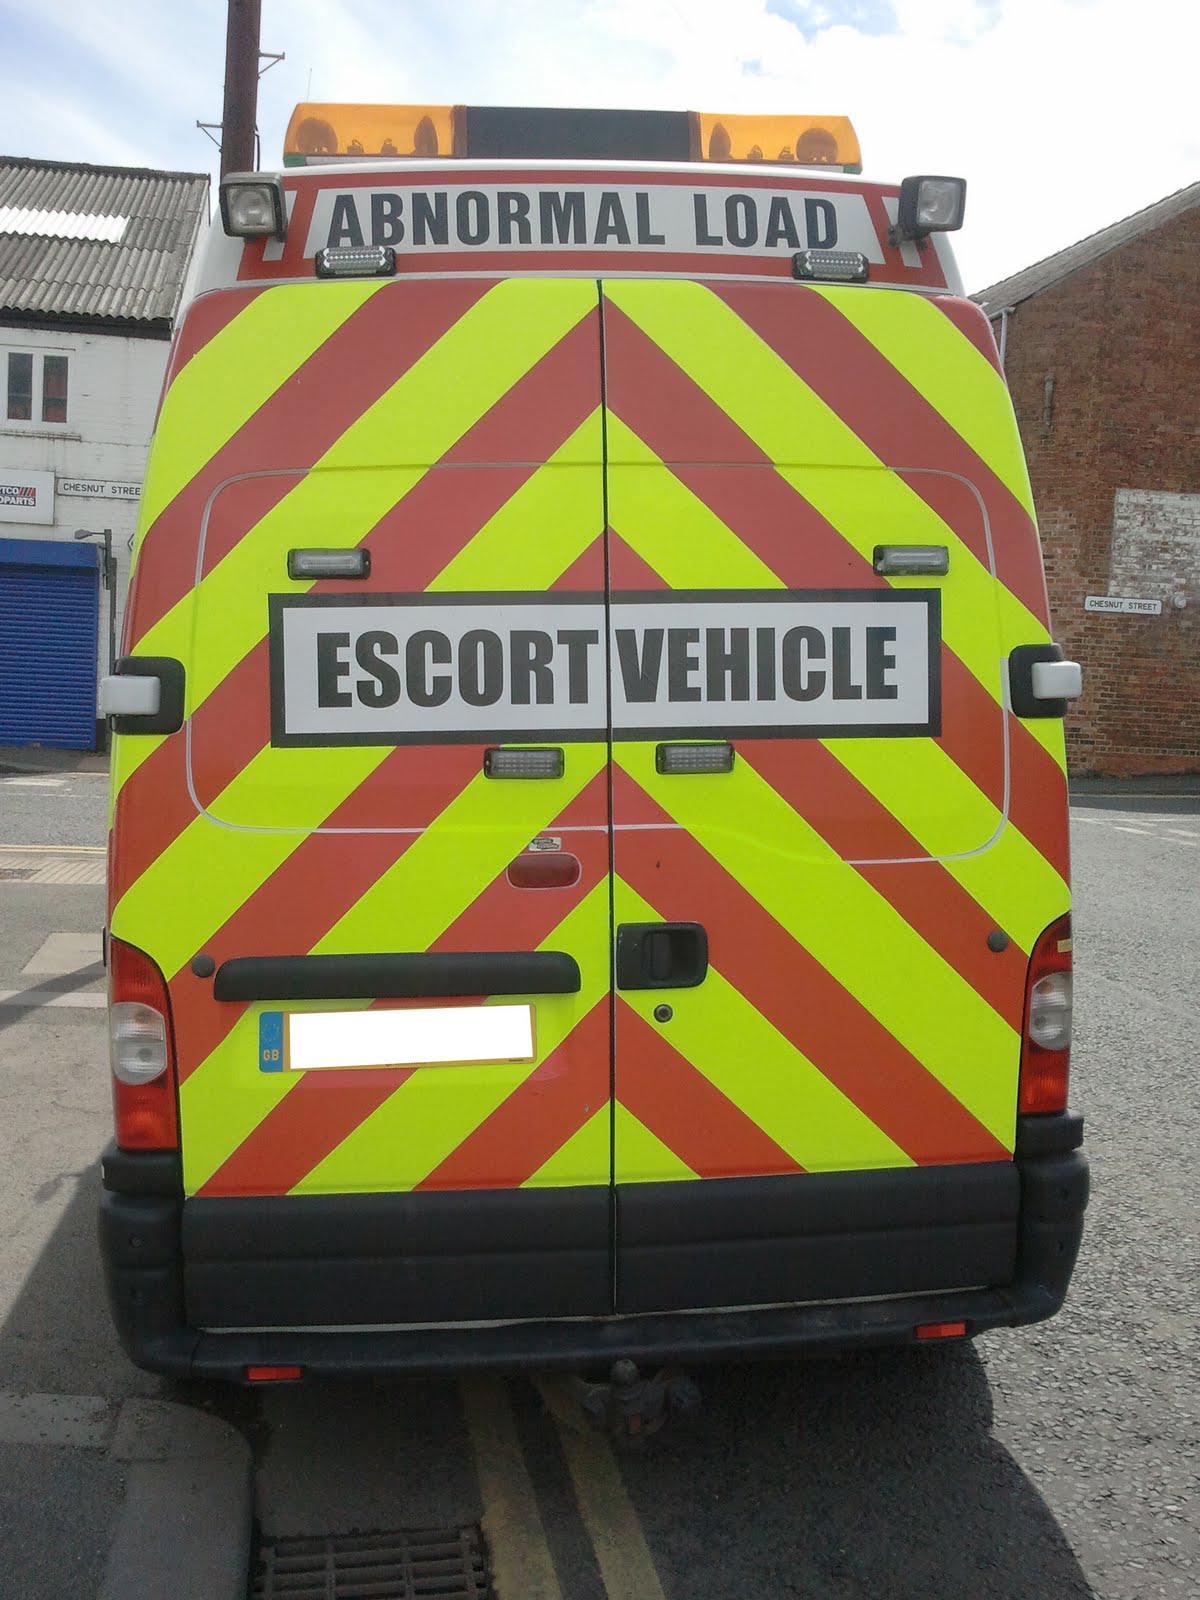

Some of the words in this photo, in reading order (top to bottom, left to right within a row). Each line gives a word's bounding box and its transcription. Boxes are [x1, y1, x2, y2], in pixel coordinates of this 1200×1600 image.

[326, 190, 665, 248] ABNORMAL
[693, 193, 839, 251] LOAD
[0, 486, 19, 495] TCO
[63, 482, 105, 494] CHESNUT
[111, 485, 141, 496] STREE
[1089, 600, 1123, 609] CHESNUT
[1128, 602, 1157, 611] STREET
[316, 629, 599, 708] ESCORT
[614, 626, 899, 703] VEHICLE
[262, 1049, 280, 1061] GB
